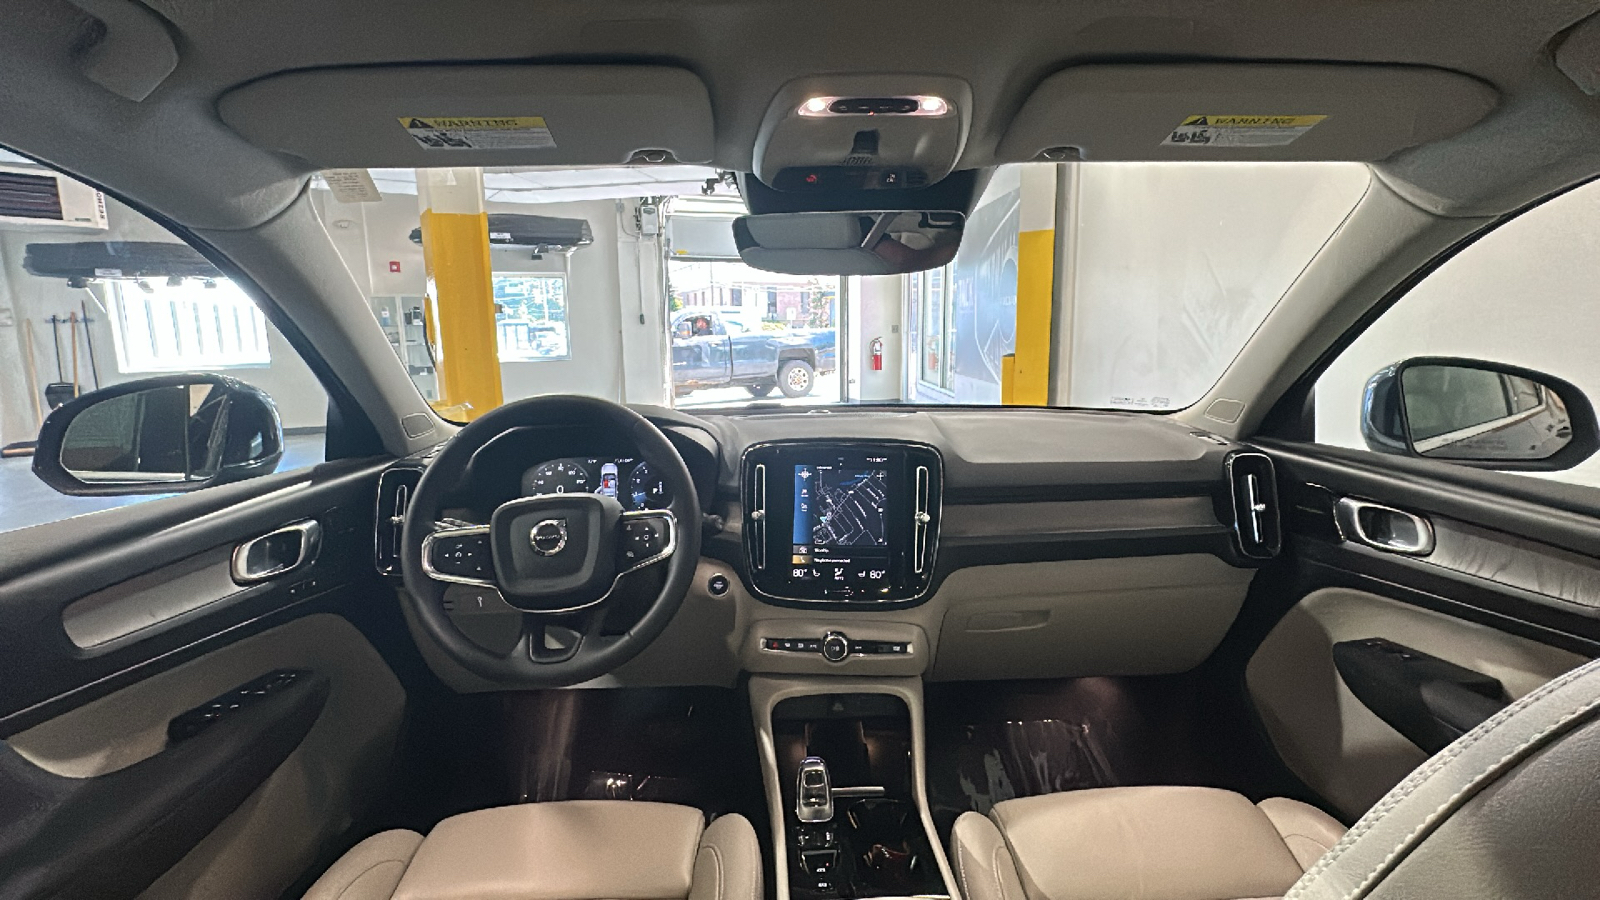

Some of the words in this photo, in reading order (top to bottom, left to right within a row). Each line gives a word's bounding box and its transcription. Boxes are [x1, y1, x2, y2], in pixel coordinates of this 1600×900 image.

[1214, 117, 1296, 125] WARNING
[96, 192, 106, 219] REZNO
[556, 485, 564, 494] 0
